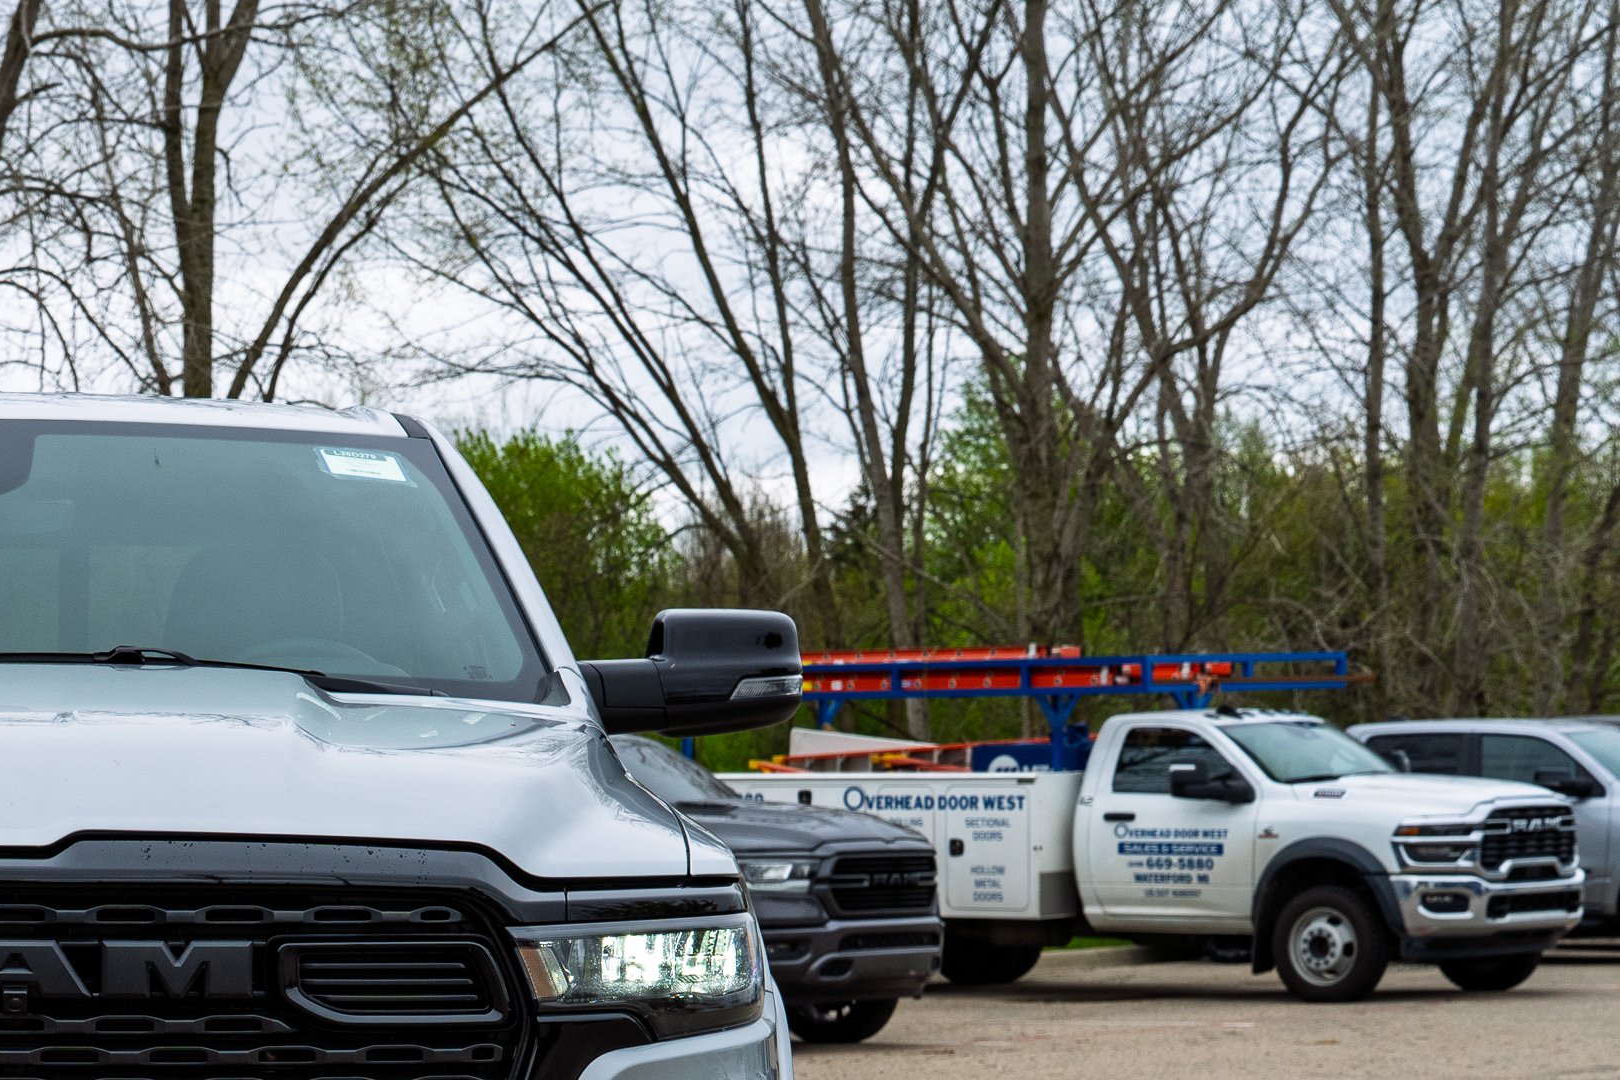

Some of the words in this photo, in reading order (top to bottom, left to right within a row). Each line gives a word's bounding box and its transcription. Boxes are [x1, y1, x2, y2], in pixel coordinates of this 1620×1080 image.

[333, 450, 377, 459] L26D279
[843, 786, 934, 811] OVERHEAD
[937, 794, 979, 811] DOOR
[982, 794, 1026, 811] WEST
[965, 817, 1011, 828] SECTIONAL
[1512, 818, 1560, 833] RAM
[972, 831, 1003, 842] DOORS
[1114, 823, 1171, 839] OVERHEAD
[1174, 828, 1200, 839] DOOR
[1202, 828, 1229, 839] WEST
[1124, 842, 1157, 854] SALES
[1172, 843, 1219, 854] SERVICE
[1146, 857, 1214, 871] 669-5880
[970, 865, 1006, 876] HOLLOW
[873, 873, 921, 886] RAM
[974, 879, 1002, 889] METAL
[1134, 873, 1193, 884] WATERFORD
[972, 891, 1003, 902] DOORS
